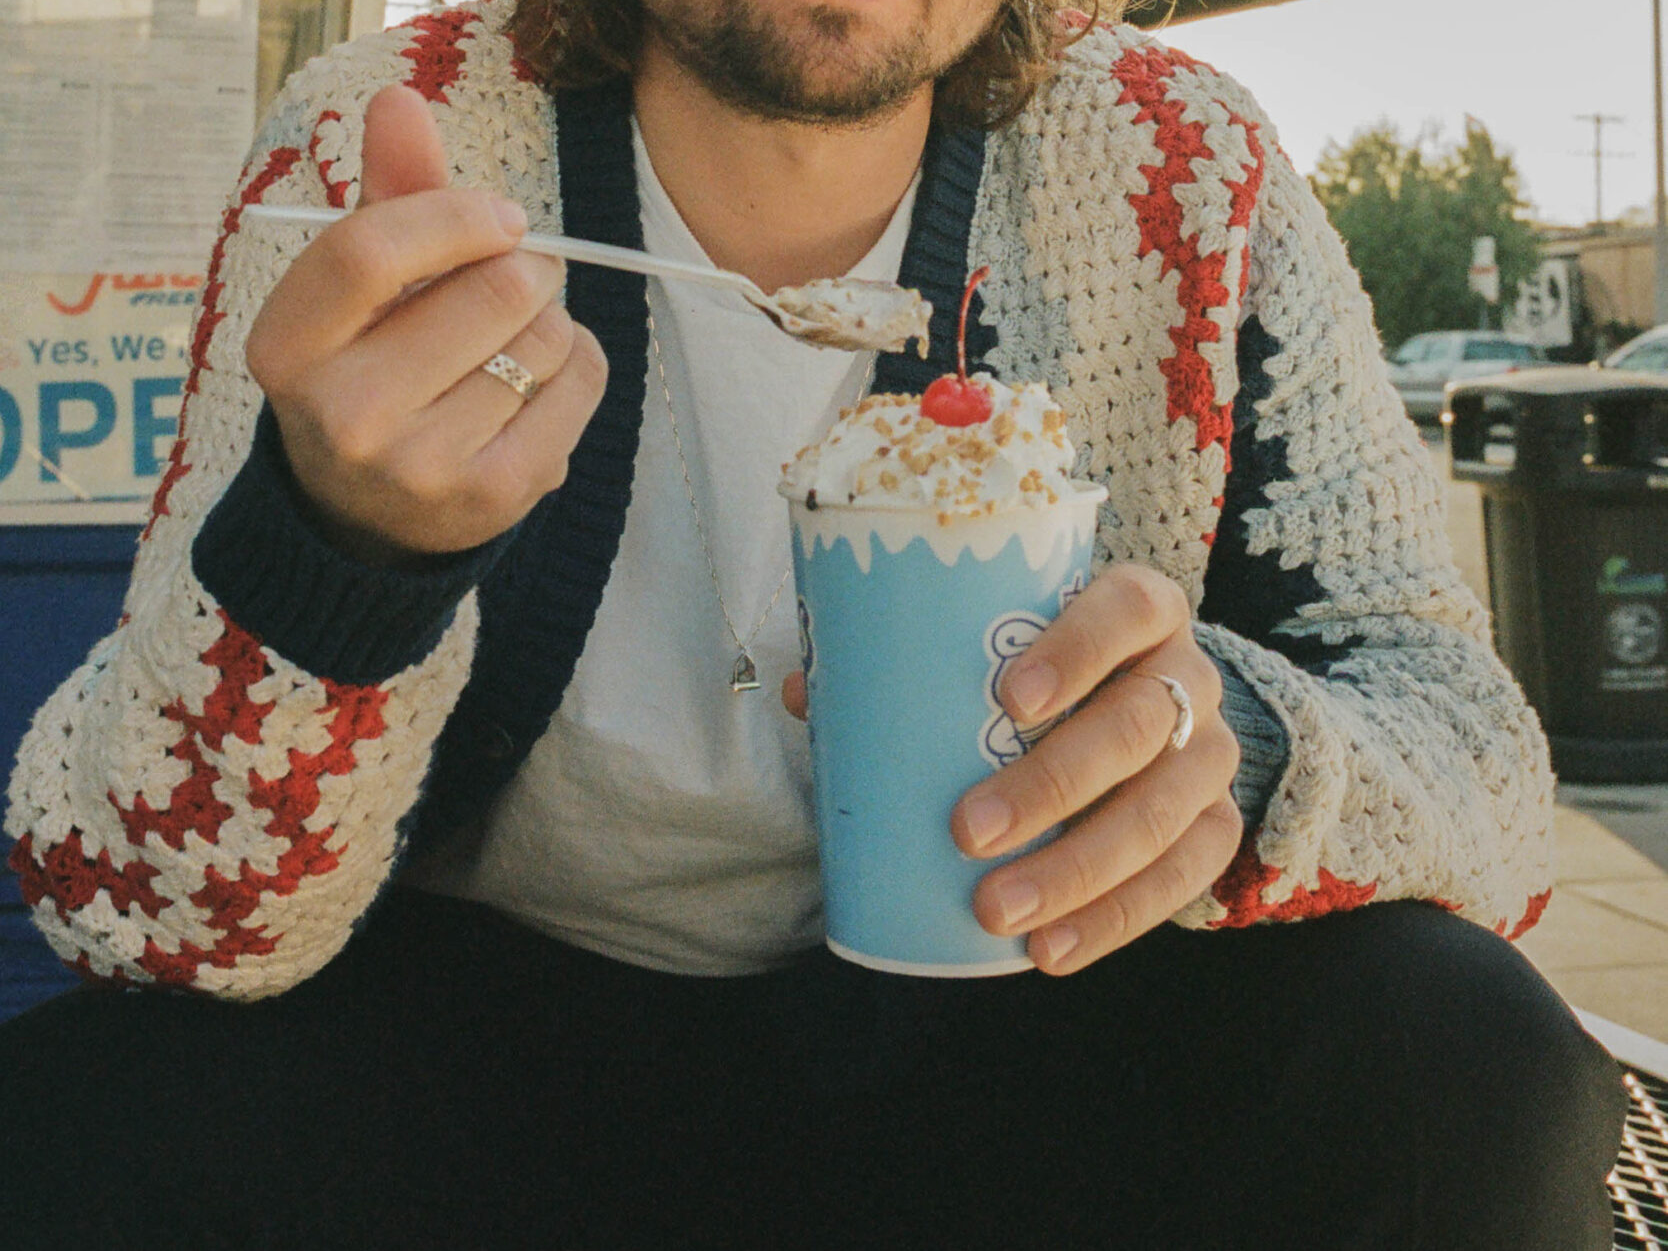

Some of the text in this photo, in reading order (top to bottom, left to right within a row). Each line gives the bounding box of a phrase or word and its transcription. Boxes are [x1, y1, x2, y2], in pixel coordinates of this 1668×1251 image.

[27, 334, 166, 366] Yes, We
[0, 377, 186, 483] PE
